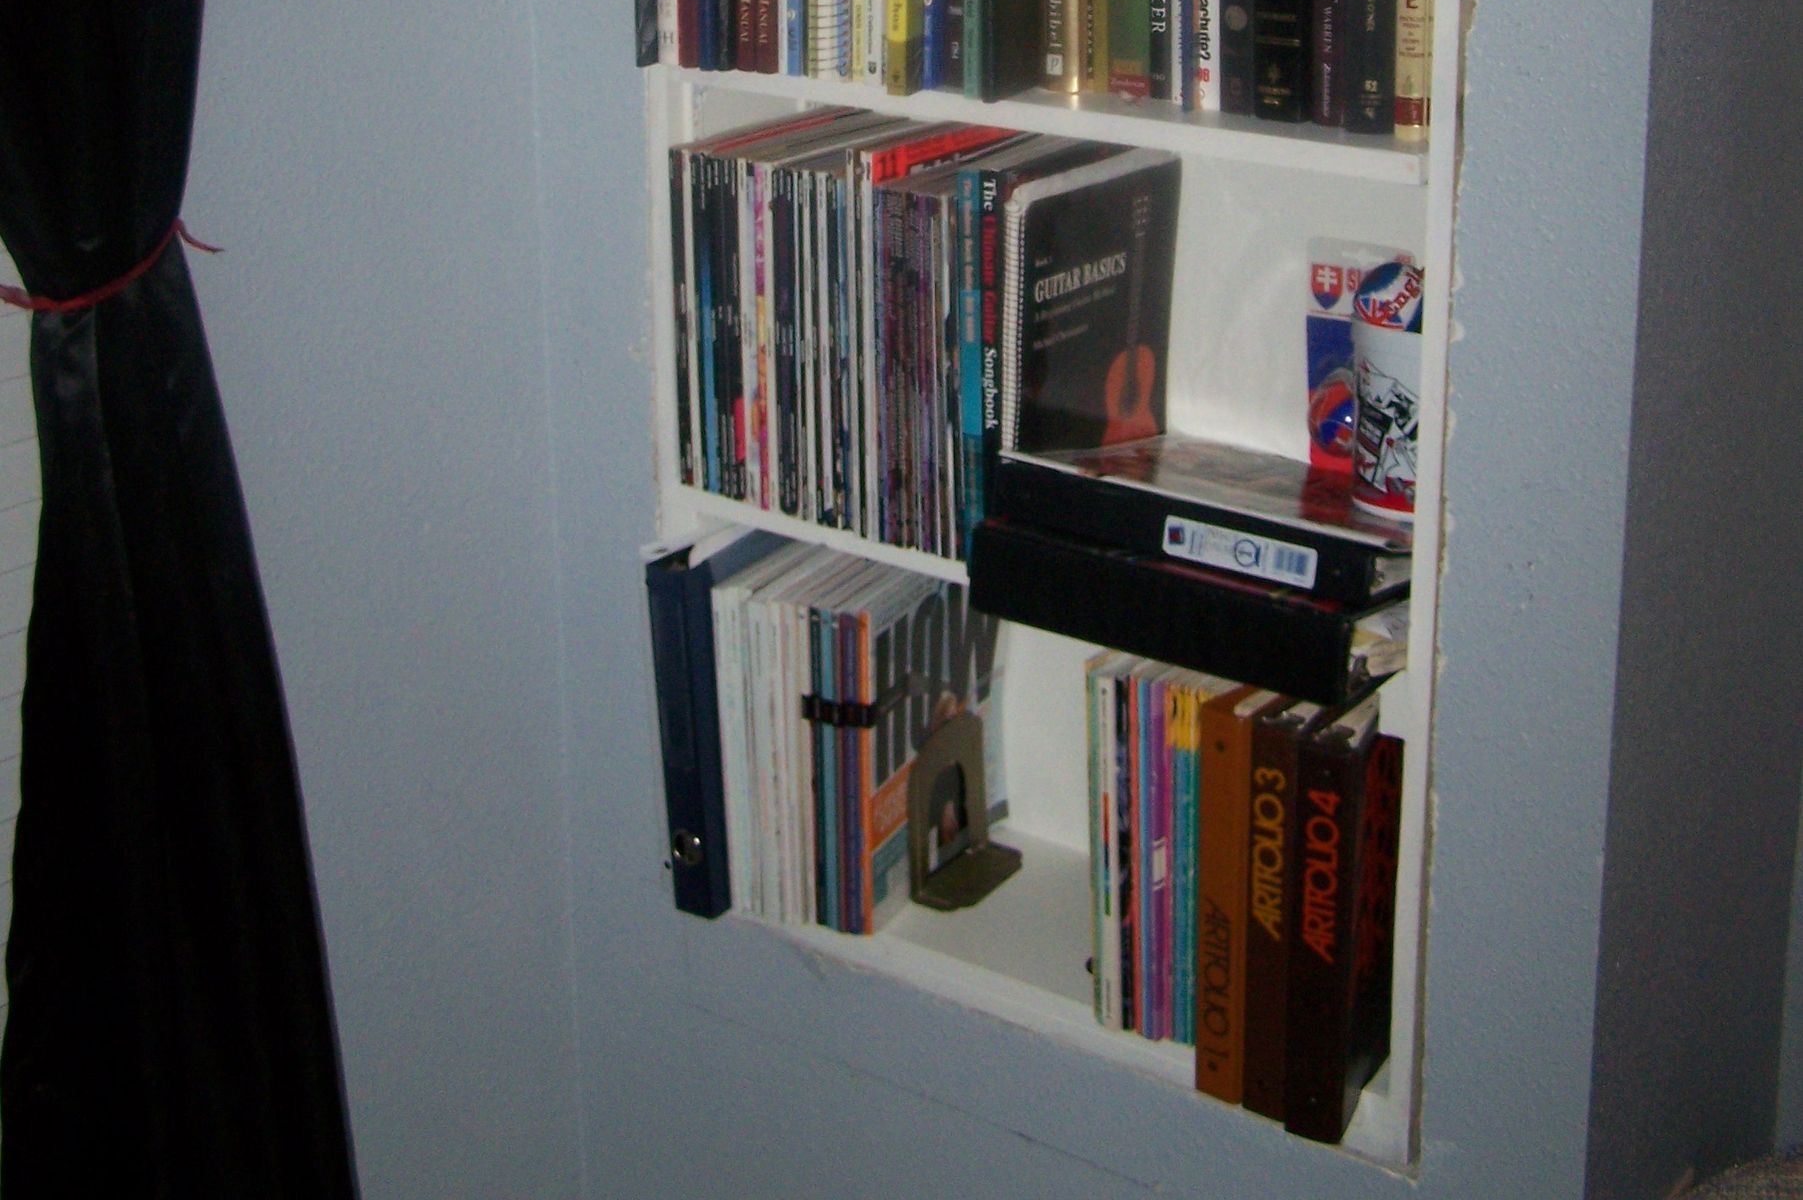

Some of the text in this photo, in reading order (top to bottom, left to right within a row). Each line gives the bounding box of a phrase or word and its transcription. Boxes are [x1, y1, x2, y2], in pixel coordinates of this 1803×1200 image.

[1322, 6, 1333, 54] WARREN
[1035, 251, 1127, 303] GUITAR BASICS
[981, 179, 999, 430] The Ultimate Guitar Songbook
[1254, 766, 1287, 791] 3
[1307, 788, 1342, 816] 4
